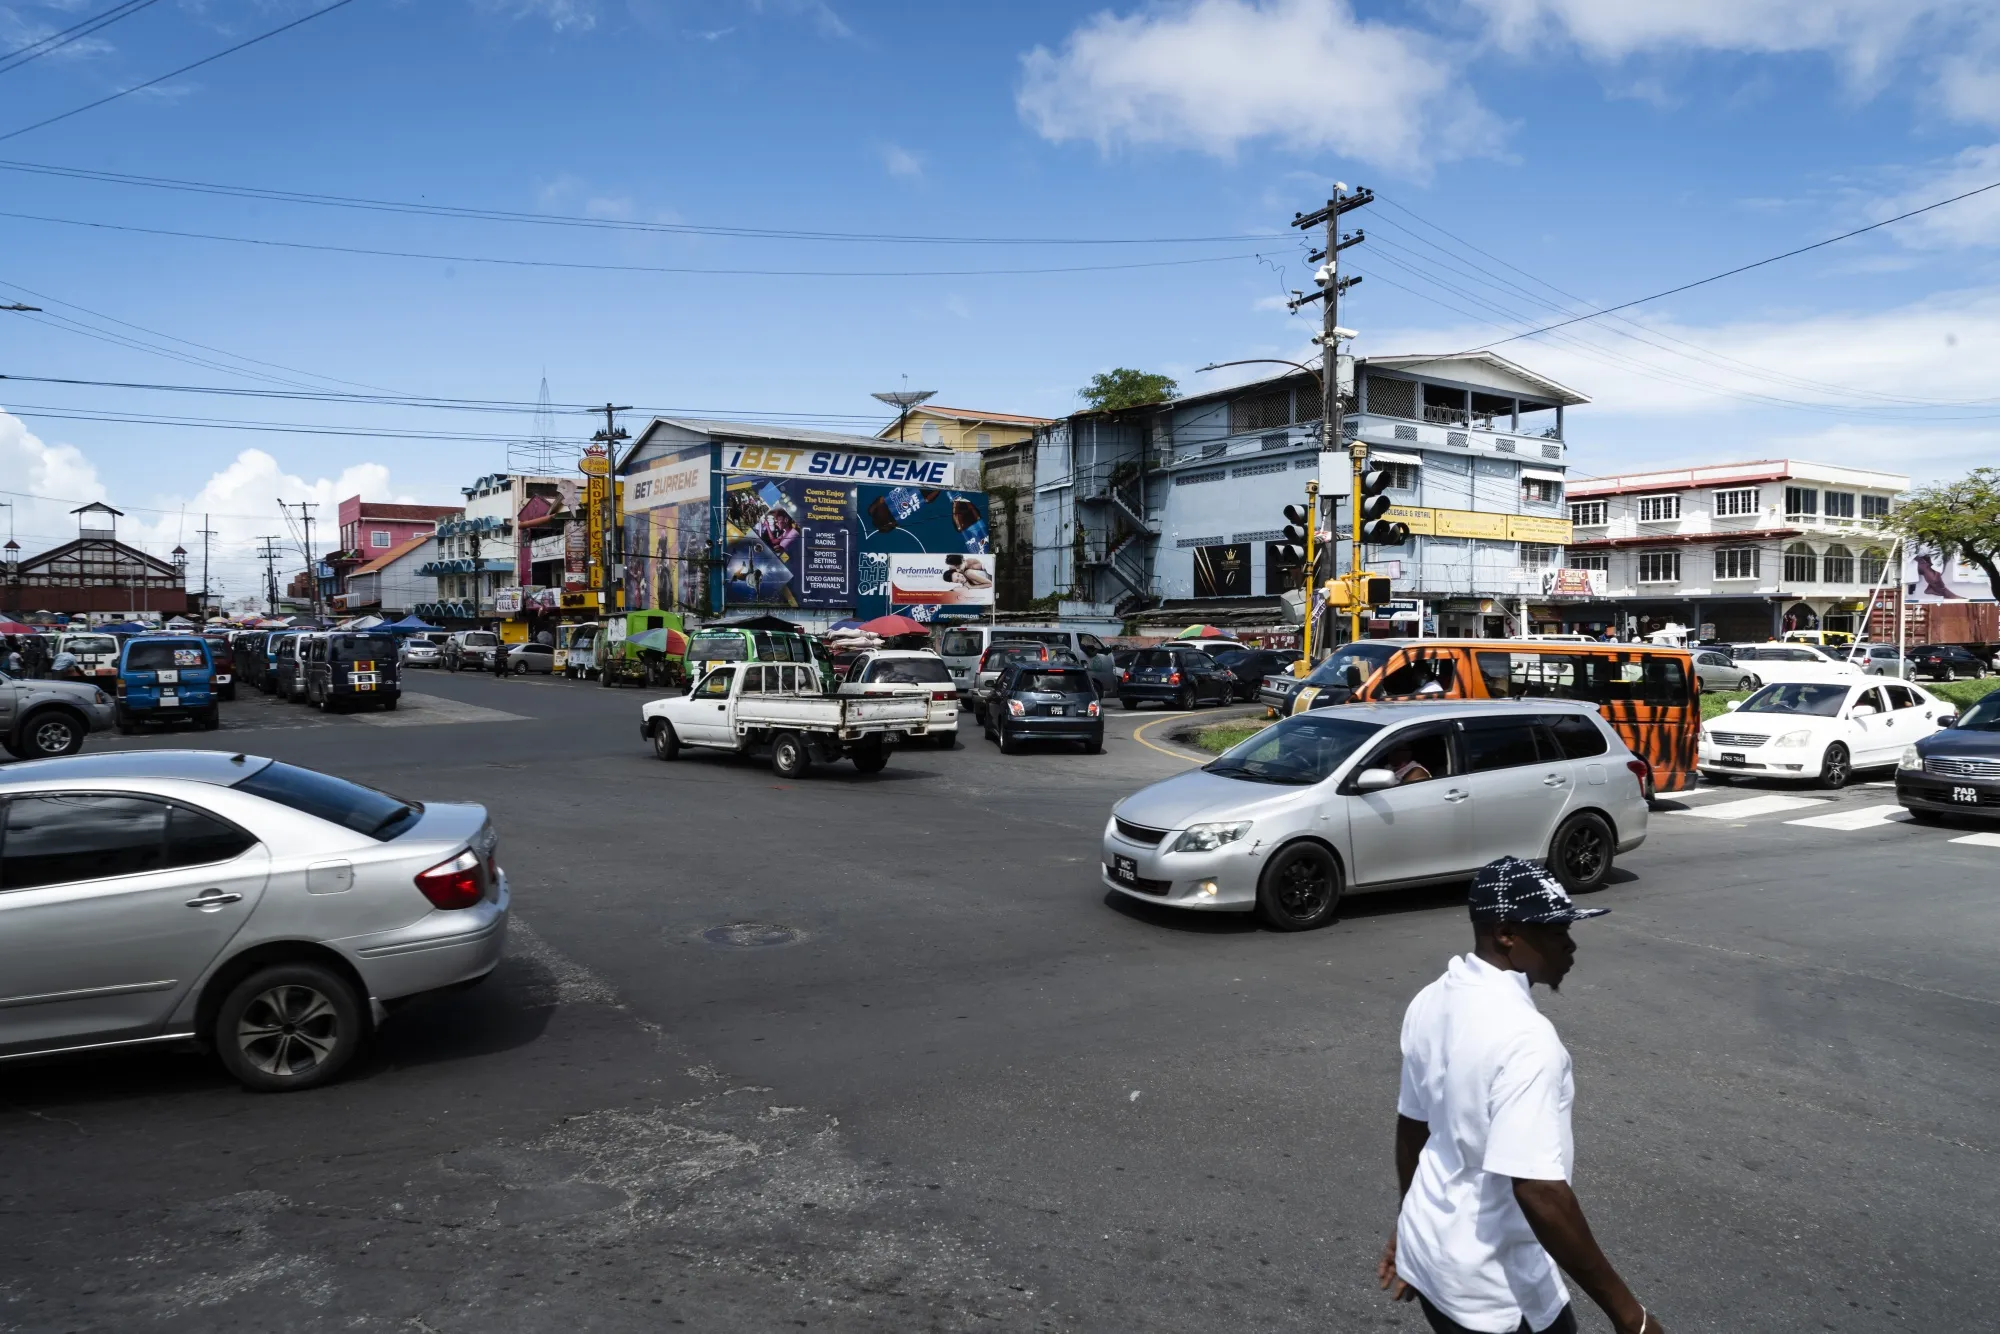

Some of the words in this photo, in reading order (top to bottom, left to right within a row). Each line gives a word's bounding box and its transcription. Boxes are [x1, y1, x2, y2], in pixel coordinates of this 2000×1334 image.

[731, 445, 804, 471] iBET
[809, 452, 948, 483] SUPREME
[653, 468, 698, 495] SUPREME
[819, 497, 847, 505] Ultimate
[812, 505, 839, 513] Gaming
[860, 552, 887, 566] FOR
[896, 567, 943, 575] PerformMax
[1953, 786, 1976, 795] PAD
[1952, 793, 1977, 802] 1141
